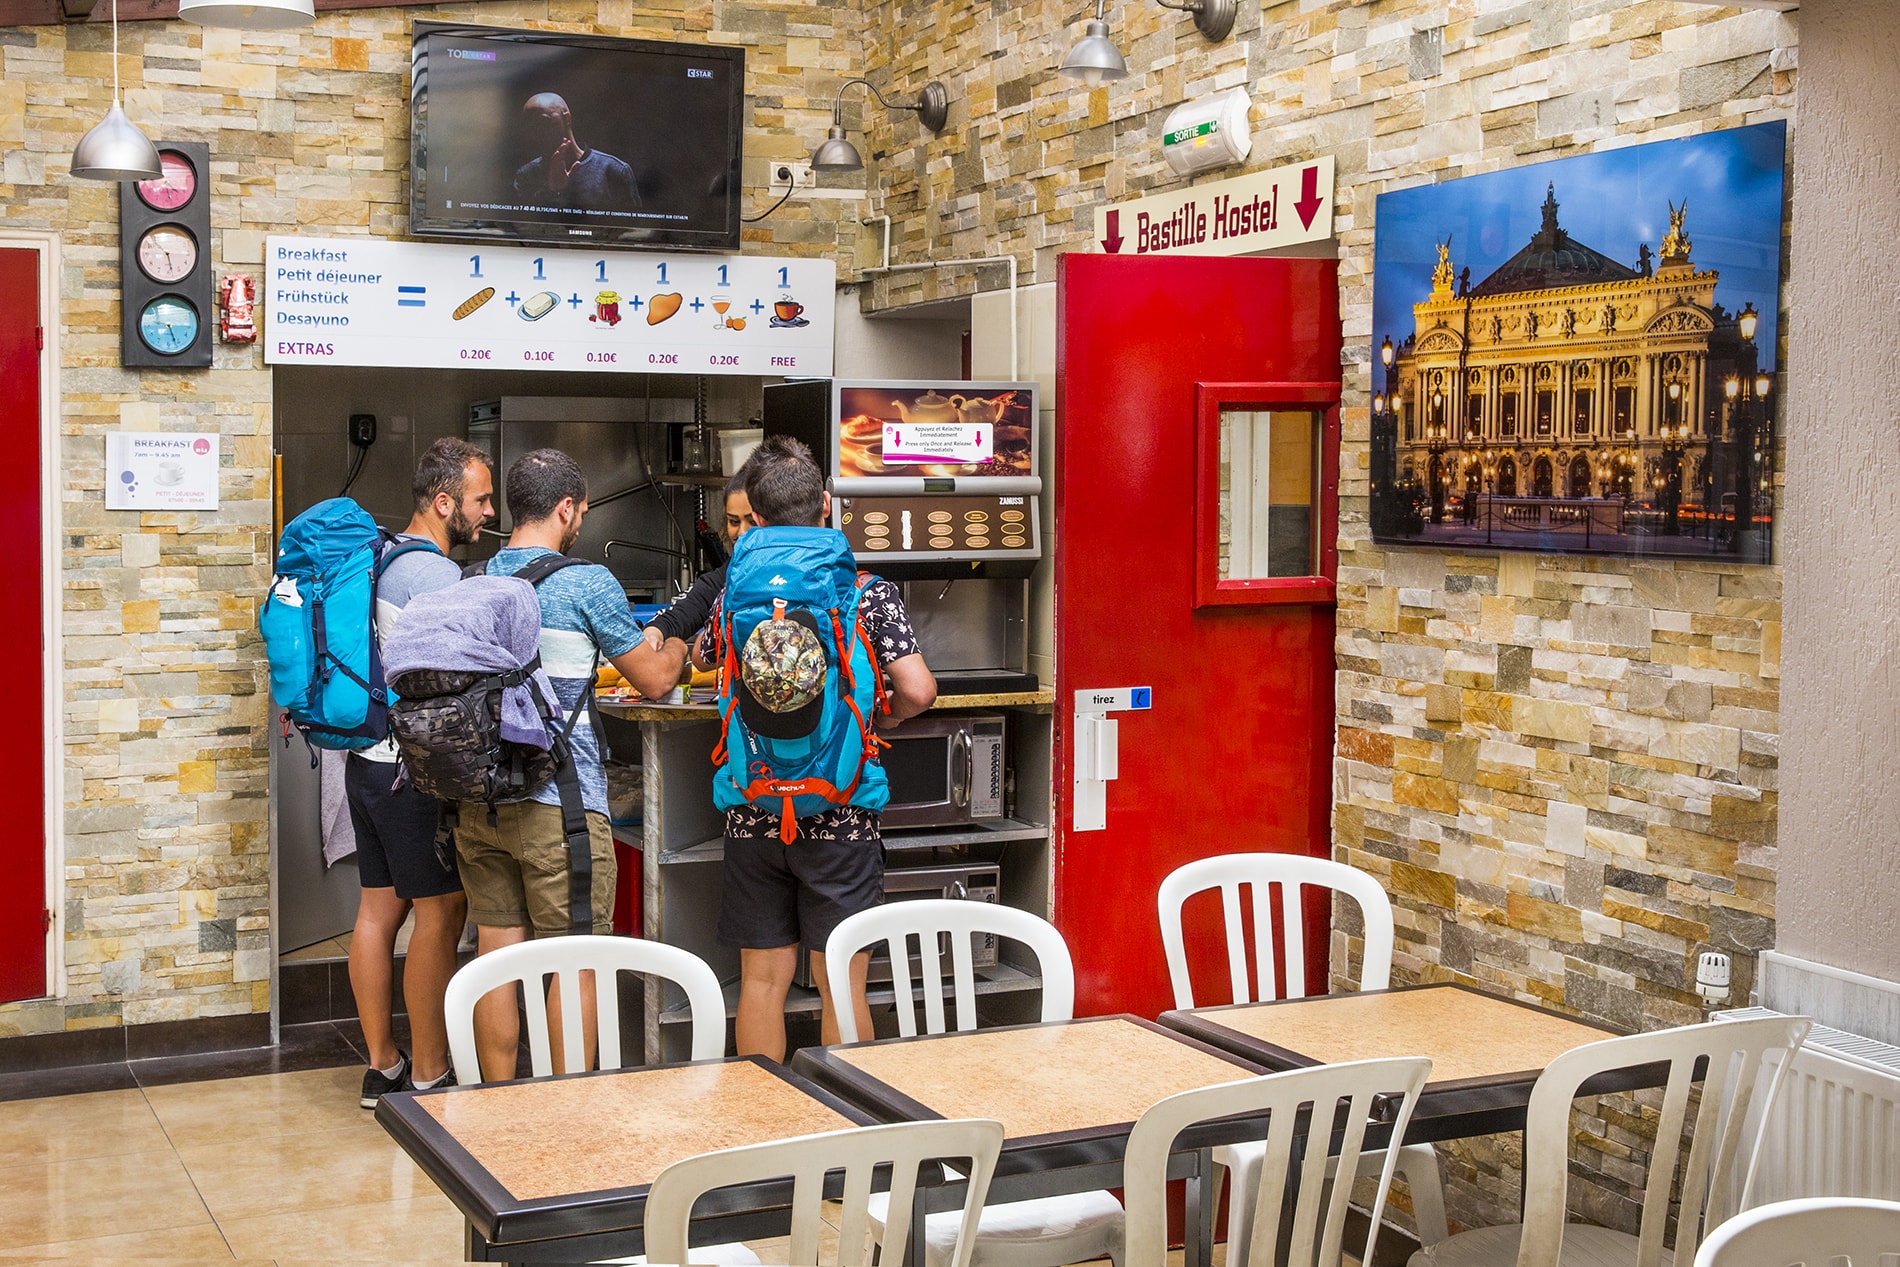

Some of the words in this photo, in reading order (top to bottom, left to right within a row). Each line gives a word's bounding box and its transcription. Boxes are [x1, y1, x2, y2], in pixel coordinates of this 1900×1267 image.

[447, 48, 468, 59] TOP
[1174, 126, 1200, 143] SORTIE
[1137, 201, 1207, 254] Bastille
[1213, 184, 1279, 240] Hostel
[277, 247, 348, 263] Breakfast
[469, 255, 484, 278] 1
[533, 257, 547, 280] 1
[595, 260, 609, 283] 1
[656, 262, 670, 285] 1
[277, 268, 312, 282] Petit
[316, 269, 382, 286] déjeuner
[717, 264, 731, 287] 1
[777, 266, 791, 288] 1
[277, 290, 349, 305] Frühstück
[277, 312, 350, 328] Desayuno
[278, 342, 334, 356] EXTRAS
[460, 349, 492, 360] 0.20€
[524, 350, 555, 361] 0.10€
[586, 352, 617, 363] 0.10€
[648, 354, 679, 364] 0.20€
[709, 355, 740, 366] 0.20€
[770, 357, 796, 367] FREE
[134, 440, 192, 448] BREAKFAST
[919, 441, 930, 449] only
[1093, 694, 1115, 704] tirez
